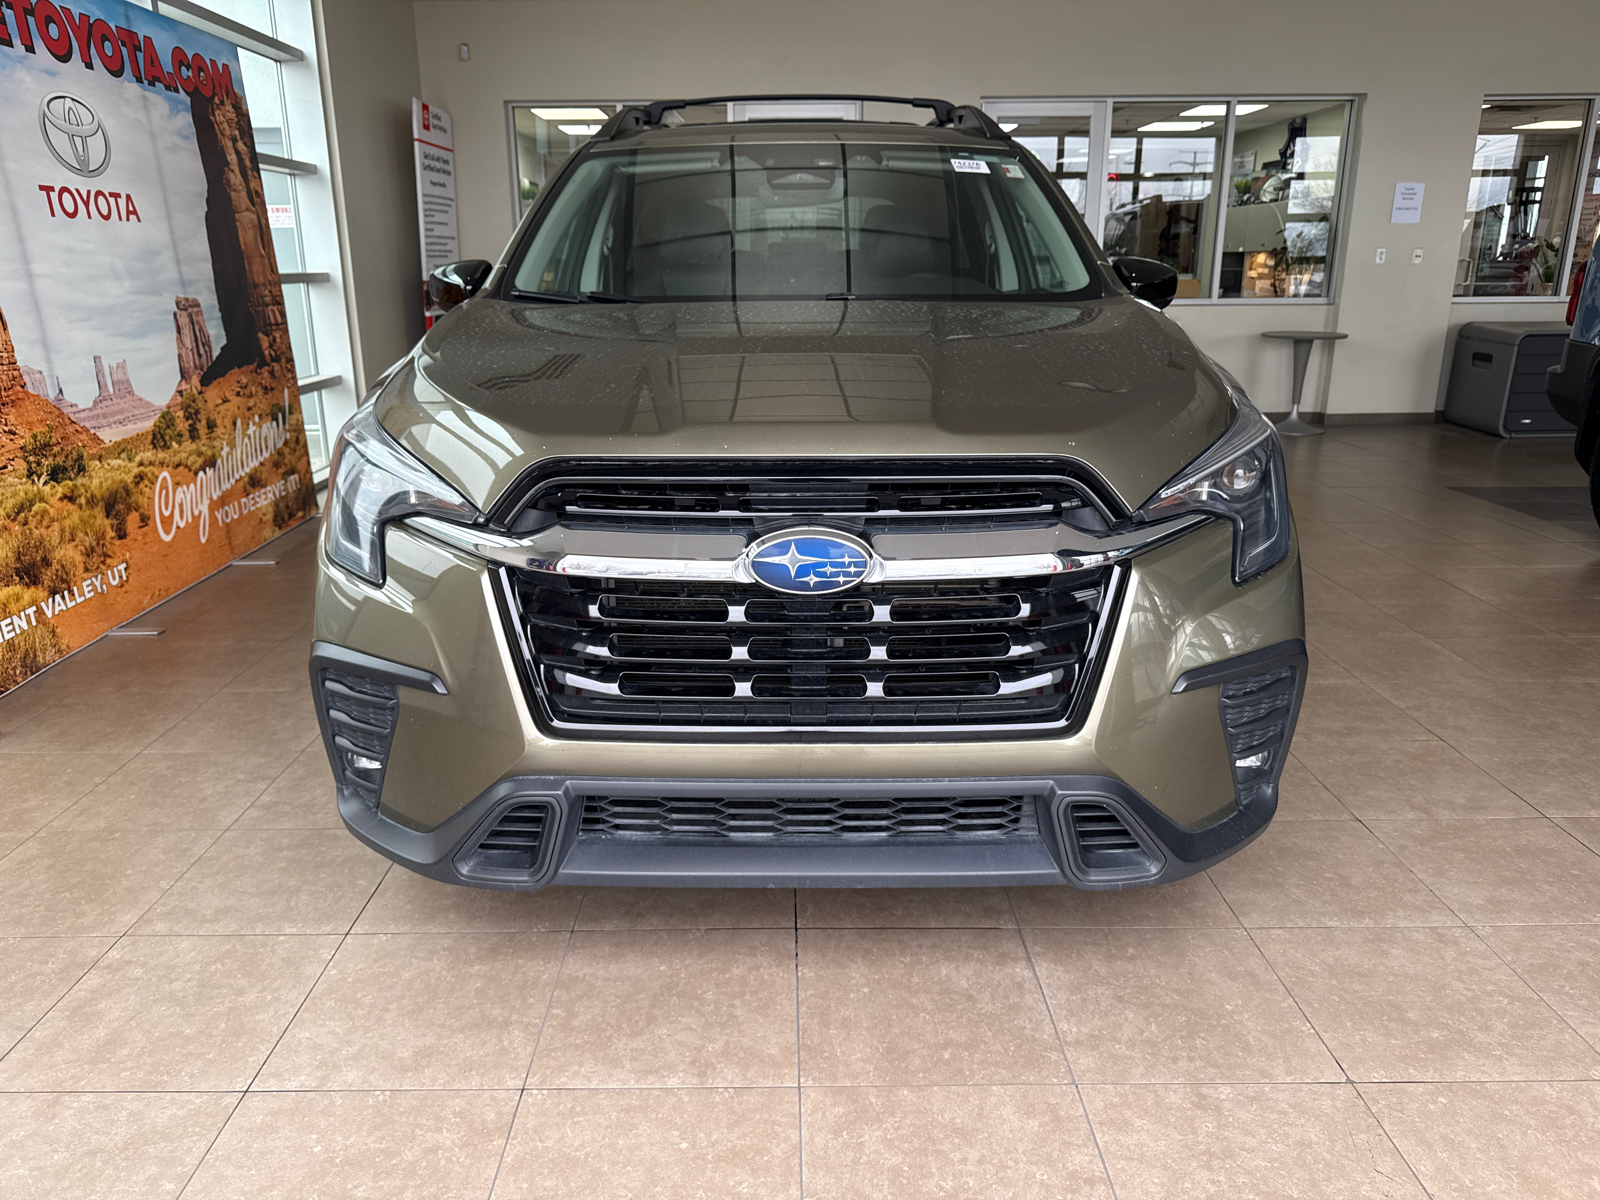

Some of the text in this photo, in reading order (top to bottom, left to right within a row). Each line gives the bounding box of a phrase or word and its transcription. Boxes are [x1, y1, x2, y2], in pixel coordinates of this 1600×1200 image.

[38, 184, 142, 223] TOYOTA
[215, 473, 301, 526] YOU DESERVE IT!
[0, 562, 127, 643] ENT VALLEY, UT
